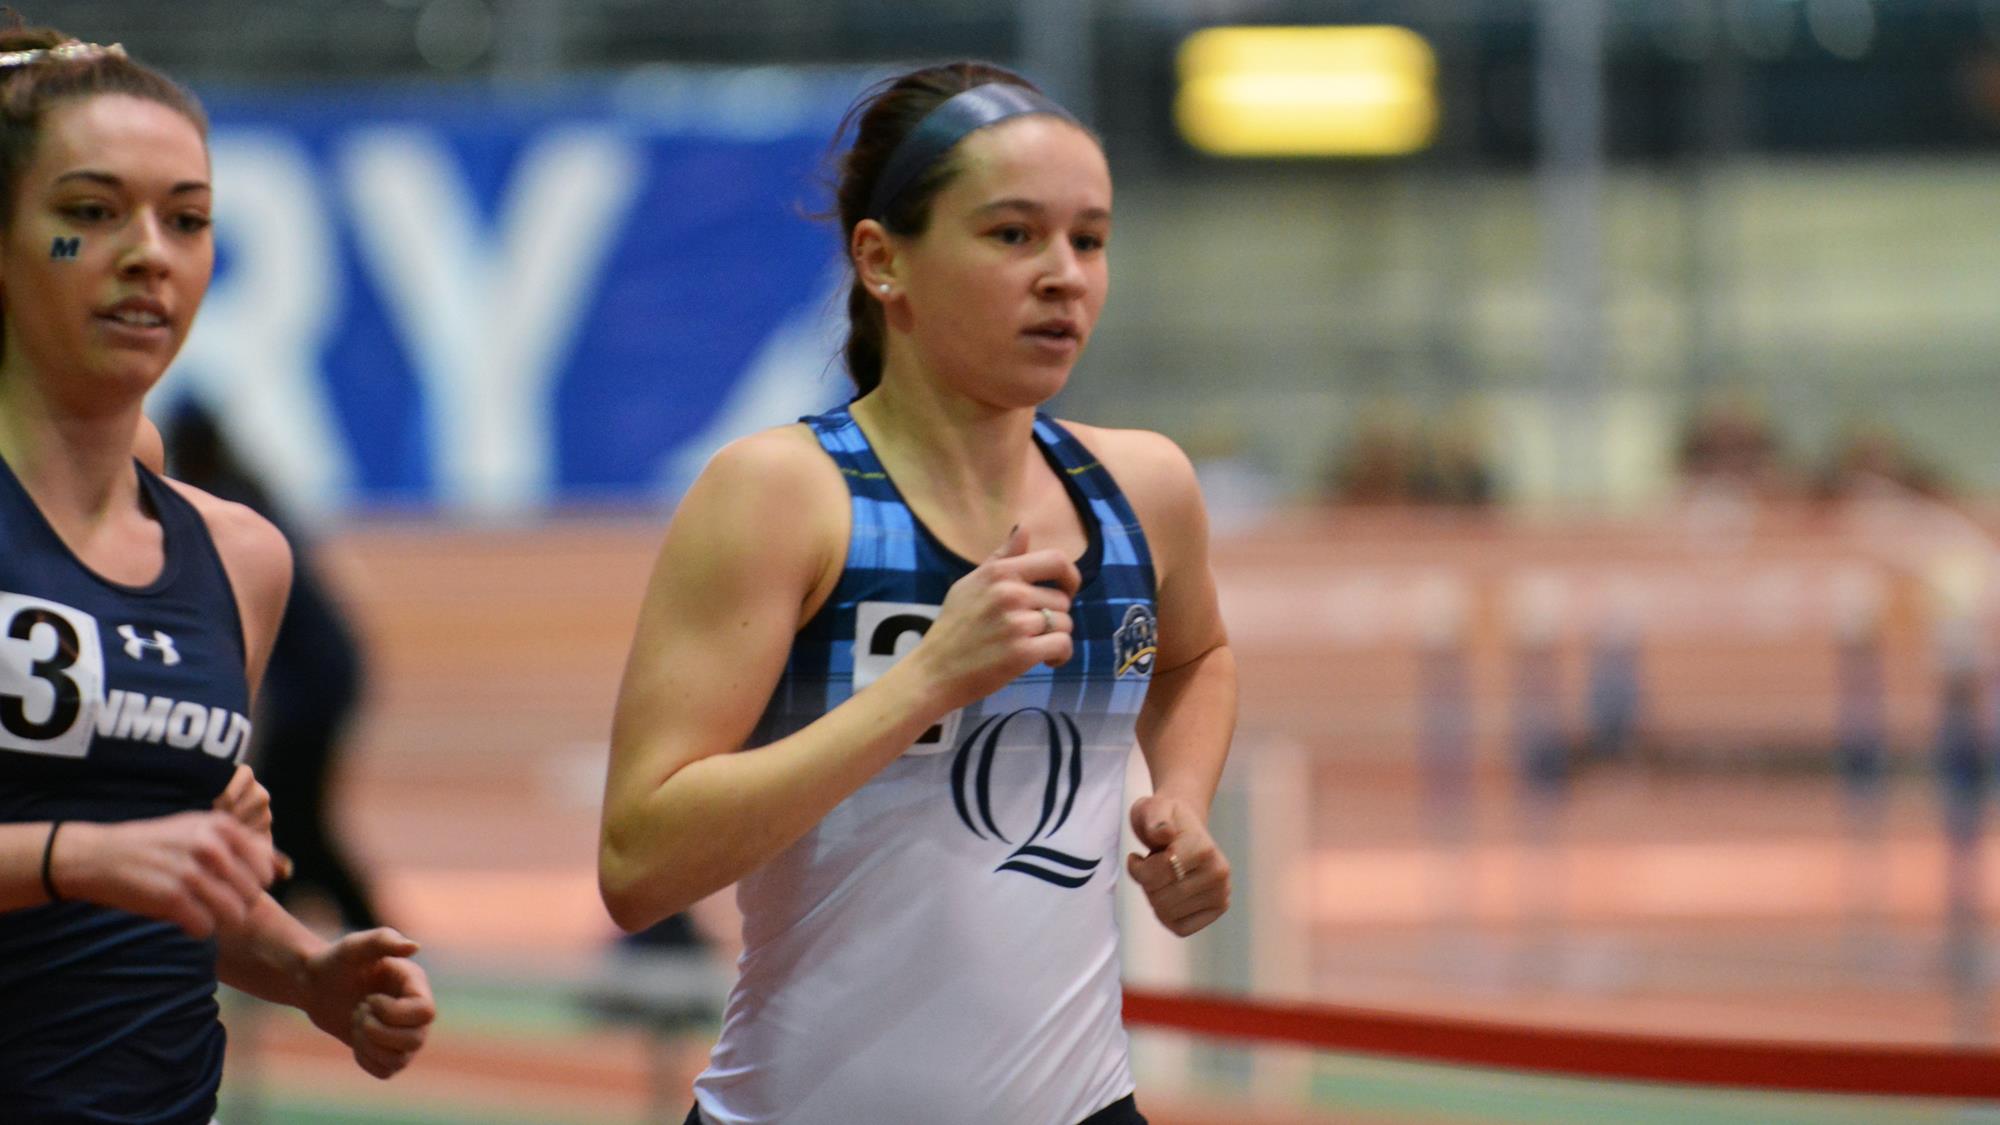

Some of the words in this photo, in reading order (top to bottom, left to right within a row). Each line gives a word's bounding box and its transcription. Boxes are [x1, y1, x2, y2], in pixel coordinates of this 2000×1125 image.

[50, 236, 81, 258] M
[0, 606, 81, 740] 3
[951, 706, 1103, 889] Q
